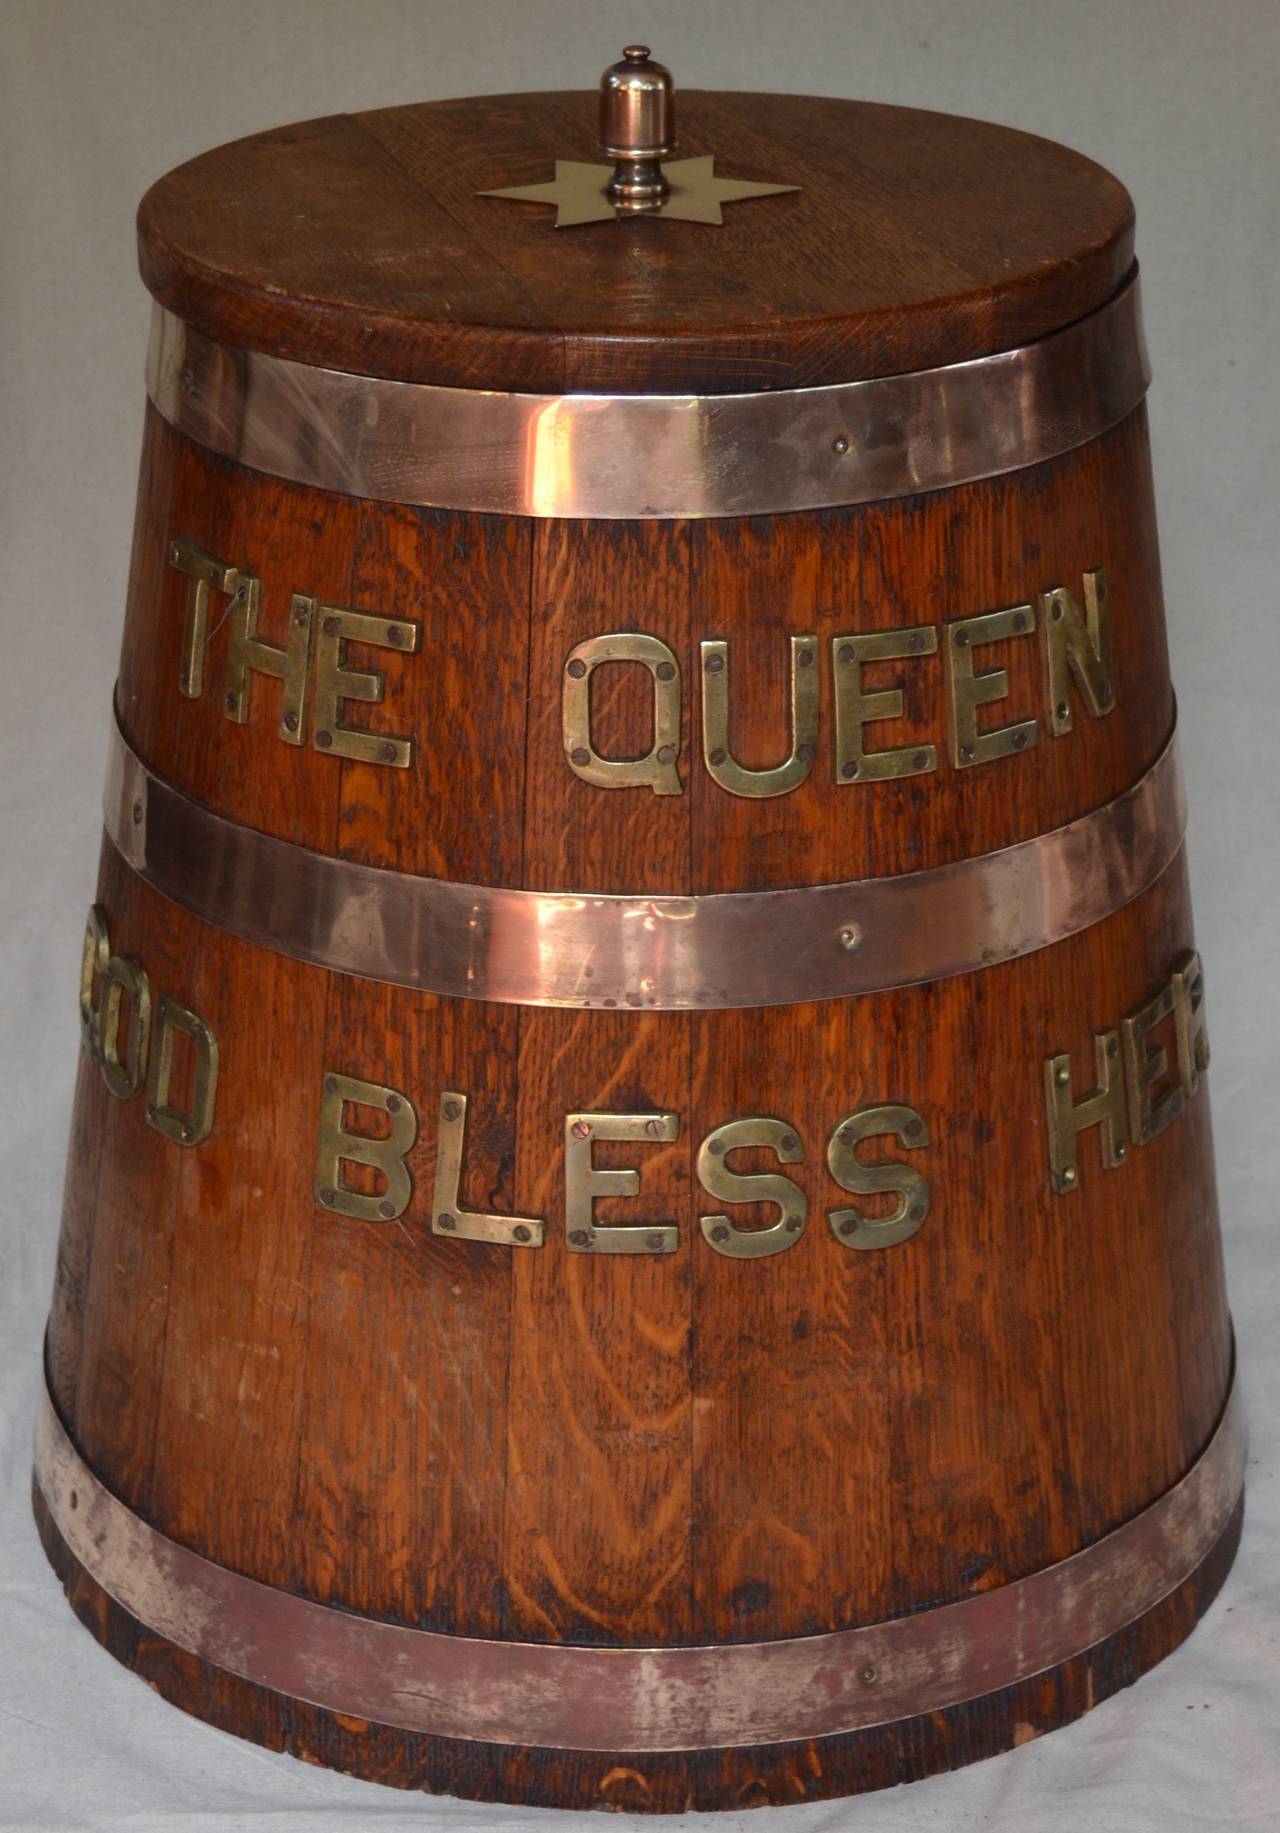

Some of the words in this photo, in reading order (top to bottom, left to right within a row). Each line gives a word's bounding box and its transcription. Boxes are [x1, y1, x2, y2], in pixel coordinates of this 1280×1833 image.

[170, 540, 419, 768] THE
[562, 568, 1117, 798] QUEEN
[314, 1071, 931, 1258] BLESS
[1044, 951, 1210, 1195] HER
